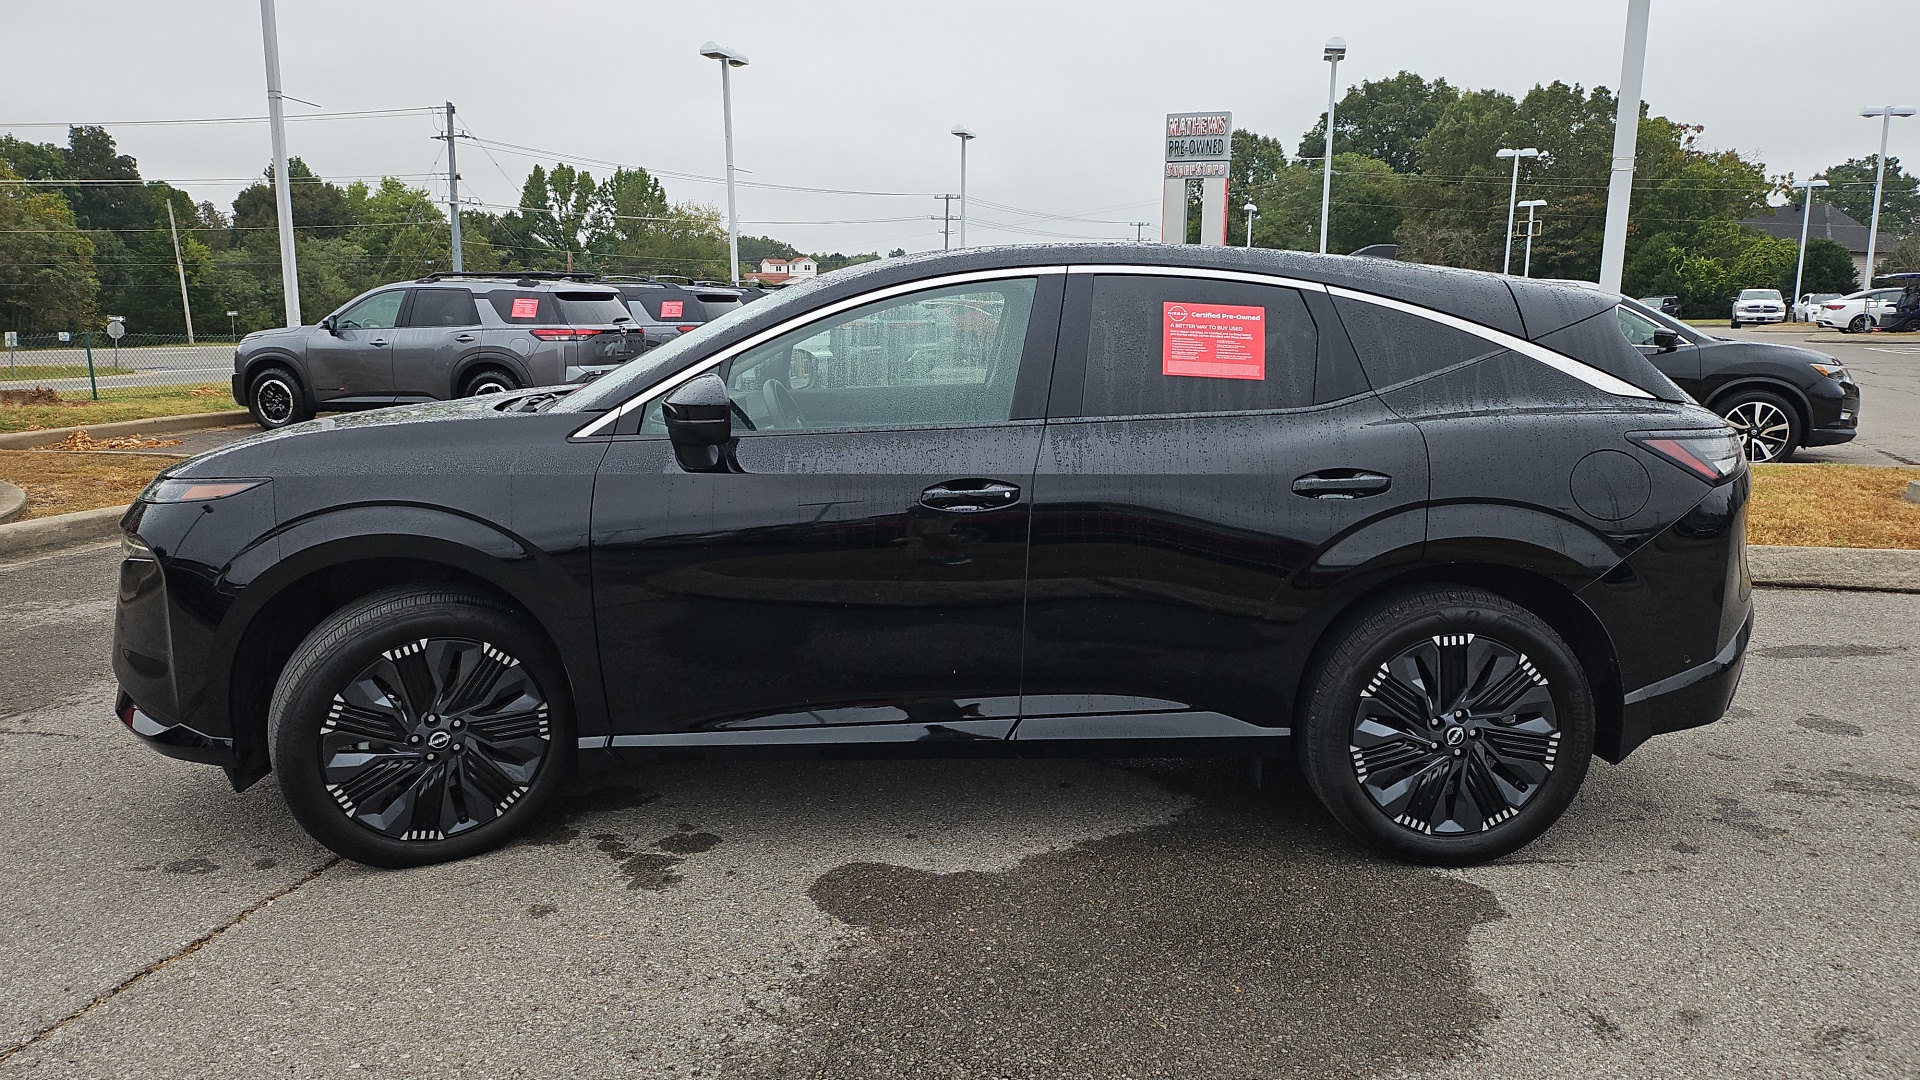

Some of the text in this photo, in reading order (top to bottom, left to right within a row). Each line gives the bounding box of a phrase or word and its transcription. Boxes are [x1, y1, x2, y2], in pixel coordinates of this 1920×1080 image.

[1167, 116, 1226, 136] MATHEWS
[1168, 139, 1224, 157] PRE-OWNED
[1191, 311, 1261, 321] Certified Pre-Owned
